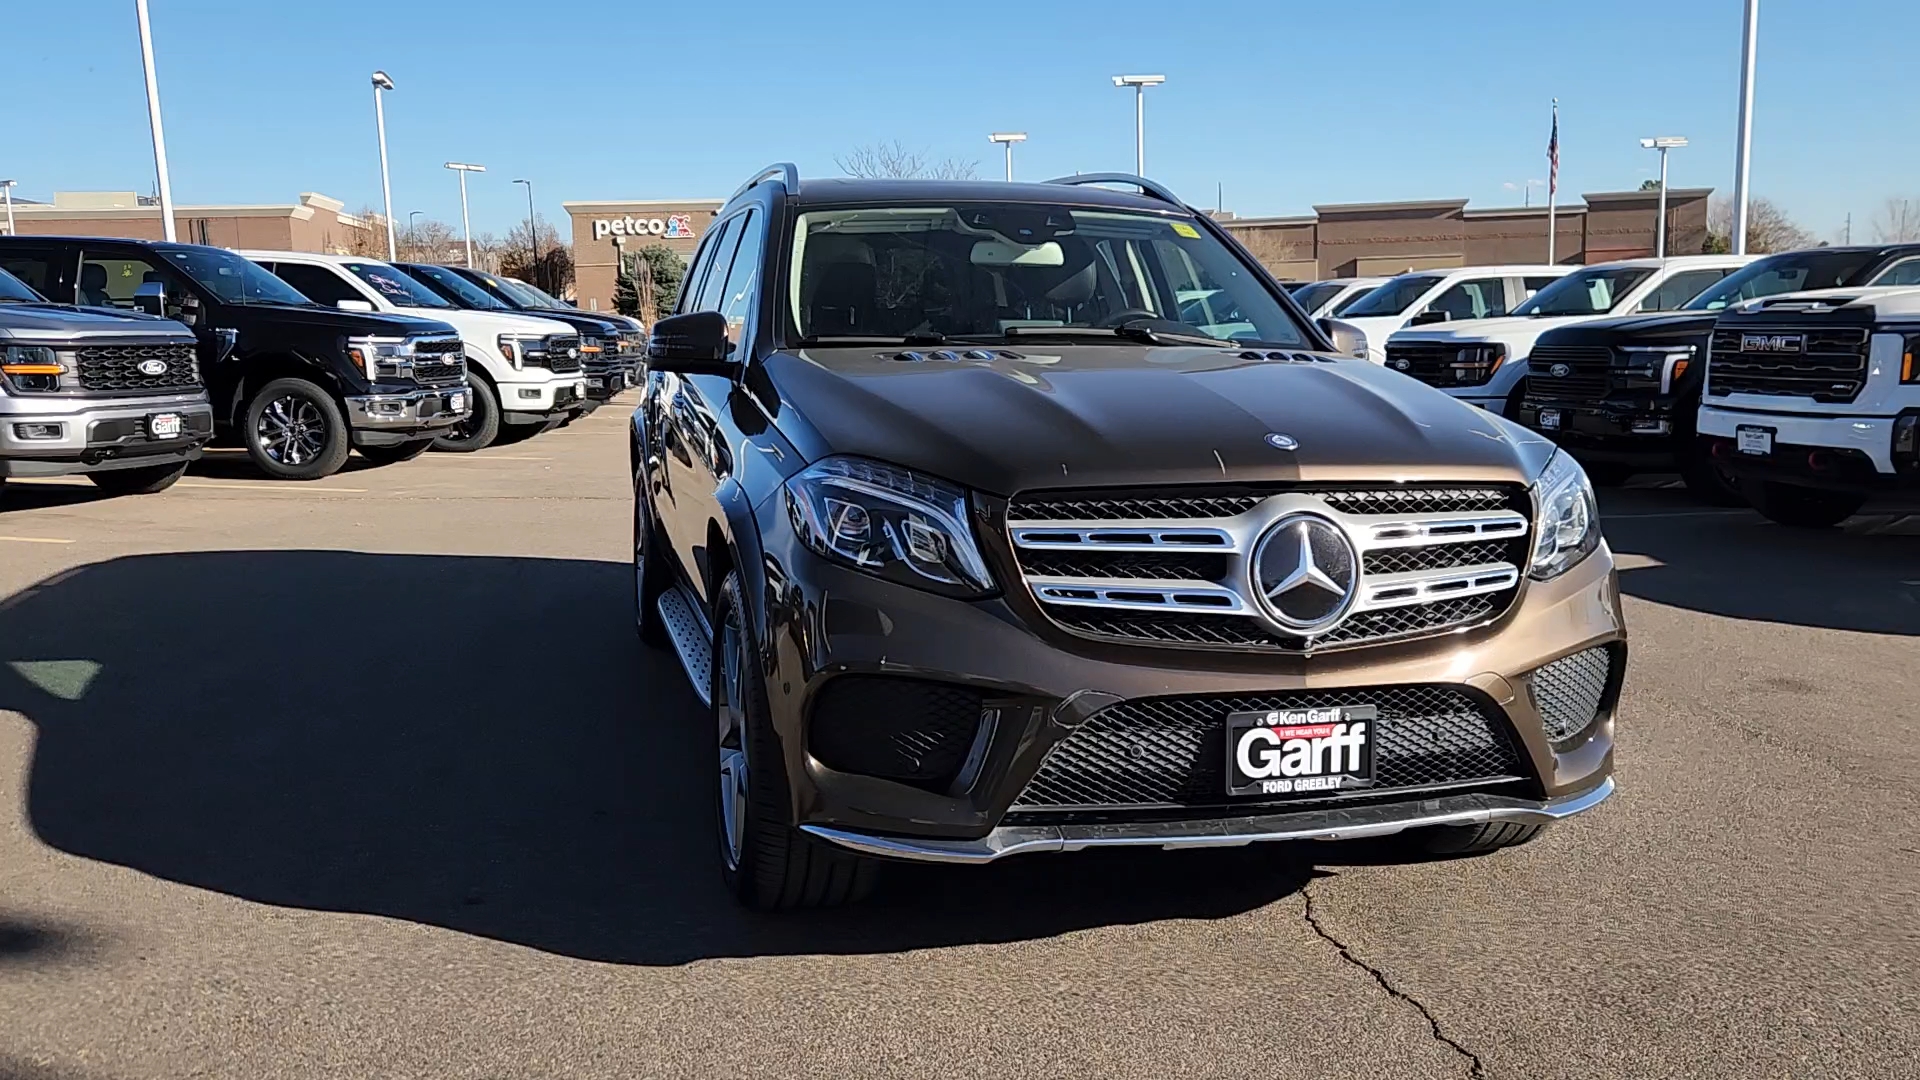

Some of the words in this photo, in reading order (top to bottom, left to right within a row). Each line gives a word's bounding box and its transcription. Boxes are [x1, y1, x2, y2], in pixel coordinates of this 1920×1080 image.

[595, 215, 665, 240] petco
[1743, 335, 1801, 351] GMC
[151, 416, 181, 435] Garff
[1279, 711, 1307, 725] Ken
[1307, 708, 1341, 724] Garff
[1284, 729, 1295, 737] WE
[1296, 728, 1313, 736] HEAR
[1236, 722, 1366, 779] Garff
[1262, 779, 1293, 794] FORD
[1293, 776, 1343, 791] GREELEY
